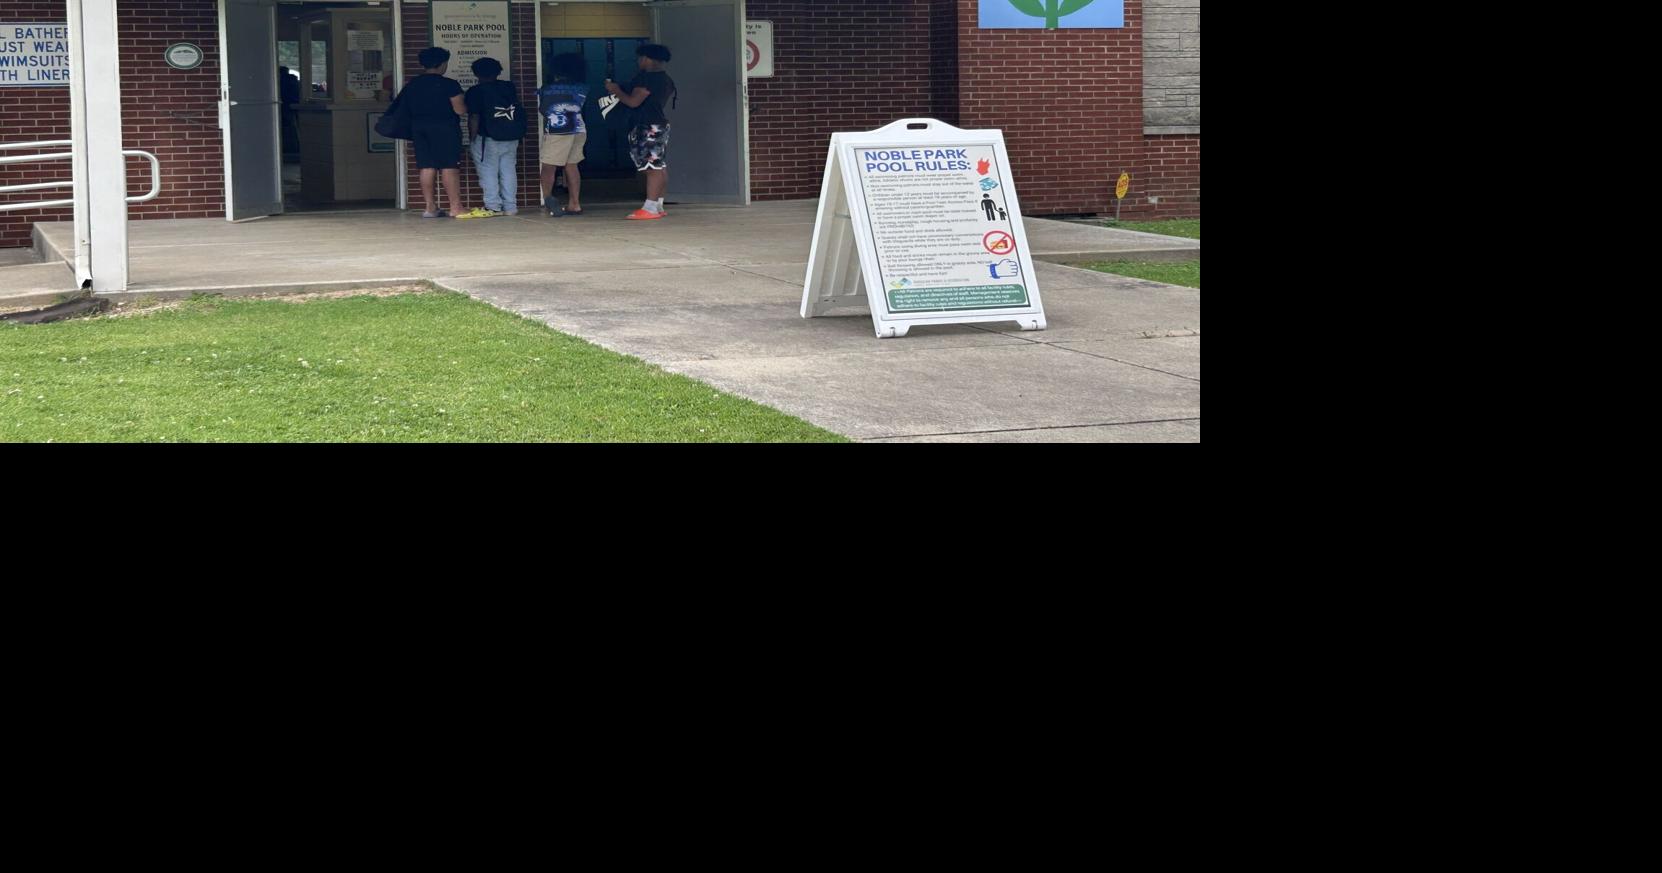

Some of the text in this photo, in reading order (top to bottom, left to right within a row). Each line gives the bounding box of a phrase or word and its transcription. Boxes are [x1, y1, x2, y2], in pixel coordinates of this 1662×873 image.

[34, 41, 68, 52] WEA
[865, 149, 967, 161] NOBLE PARK
[866, 160, 971, 172] POOL RULES:
